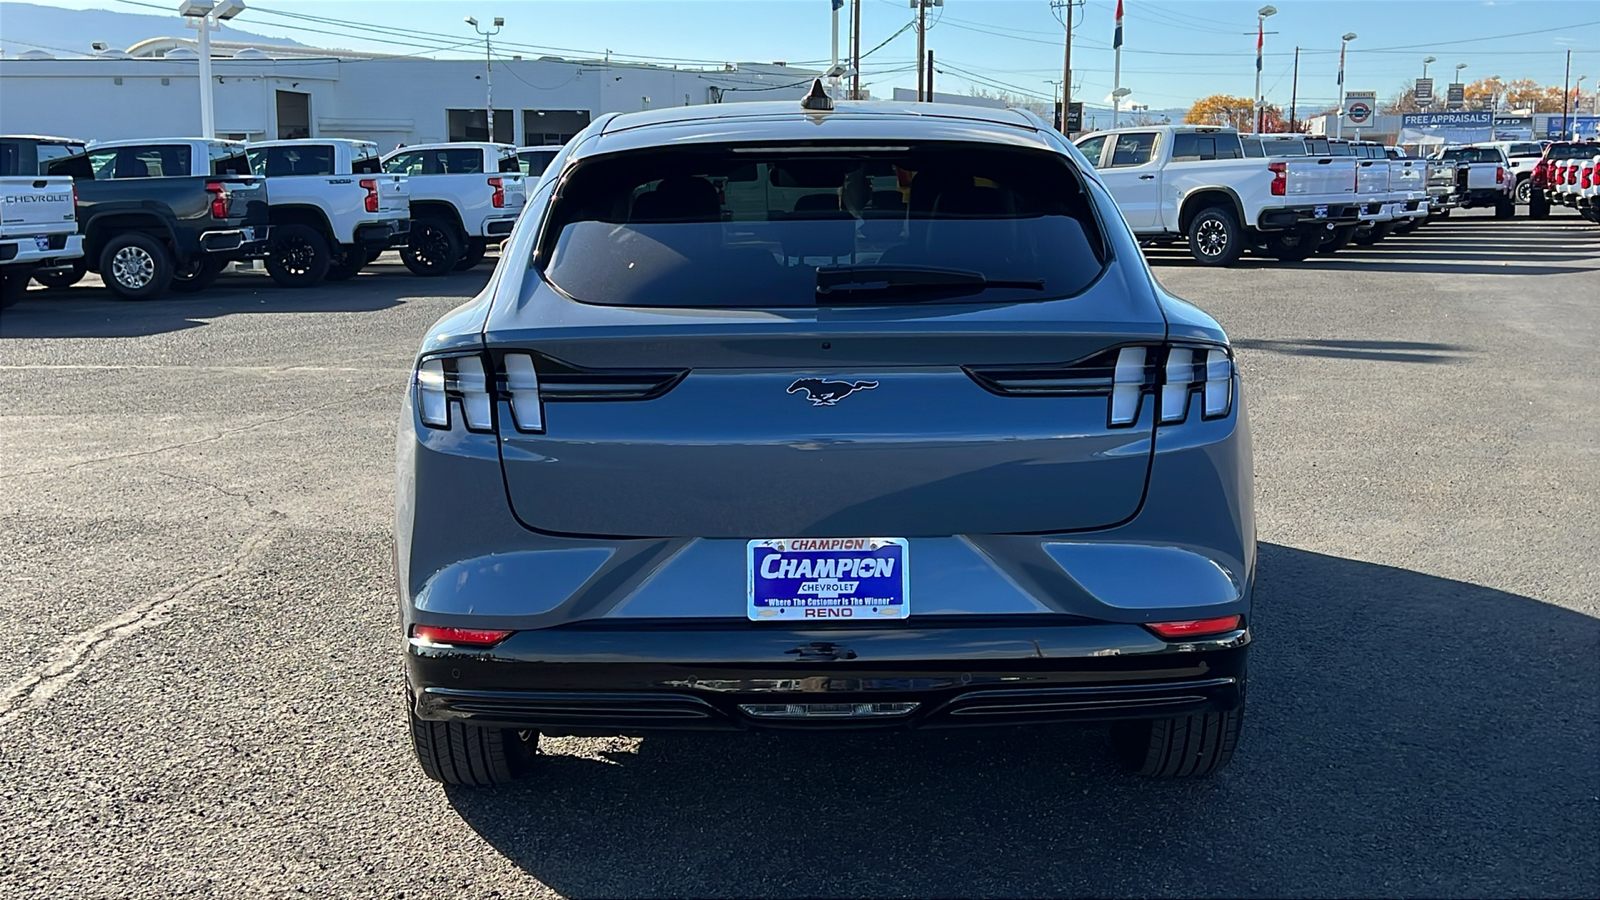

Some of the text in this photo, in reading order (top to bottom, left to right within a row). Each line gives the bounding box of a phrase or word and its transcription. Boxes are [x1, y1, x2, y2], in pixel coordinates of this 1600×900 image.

[1405, 114, 1490, 124] FREE APPRAISALS!
[6, 194, 70, 204] CHEVROLET
[790, 539, 865, 551] CHAMPION
[760, 553, 895, 579] CHAMPION
[801, 583, 854, 592] CHEVROLET
[793, 598, 805, 606] The
[807, 598, 840, 606] Customer
[842, 598, 849, 606] Is
[804, 608, 853, 618] RENO
